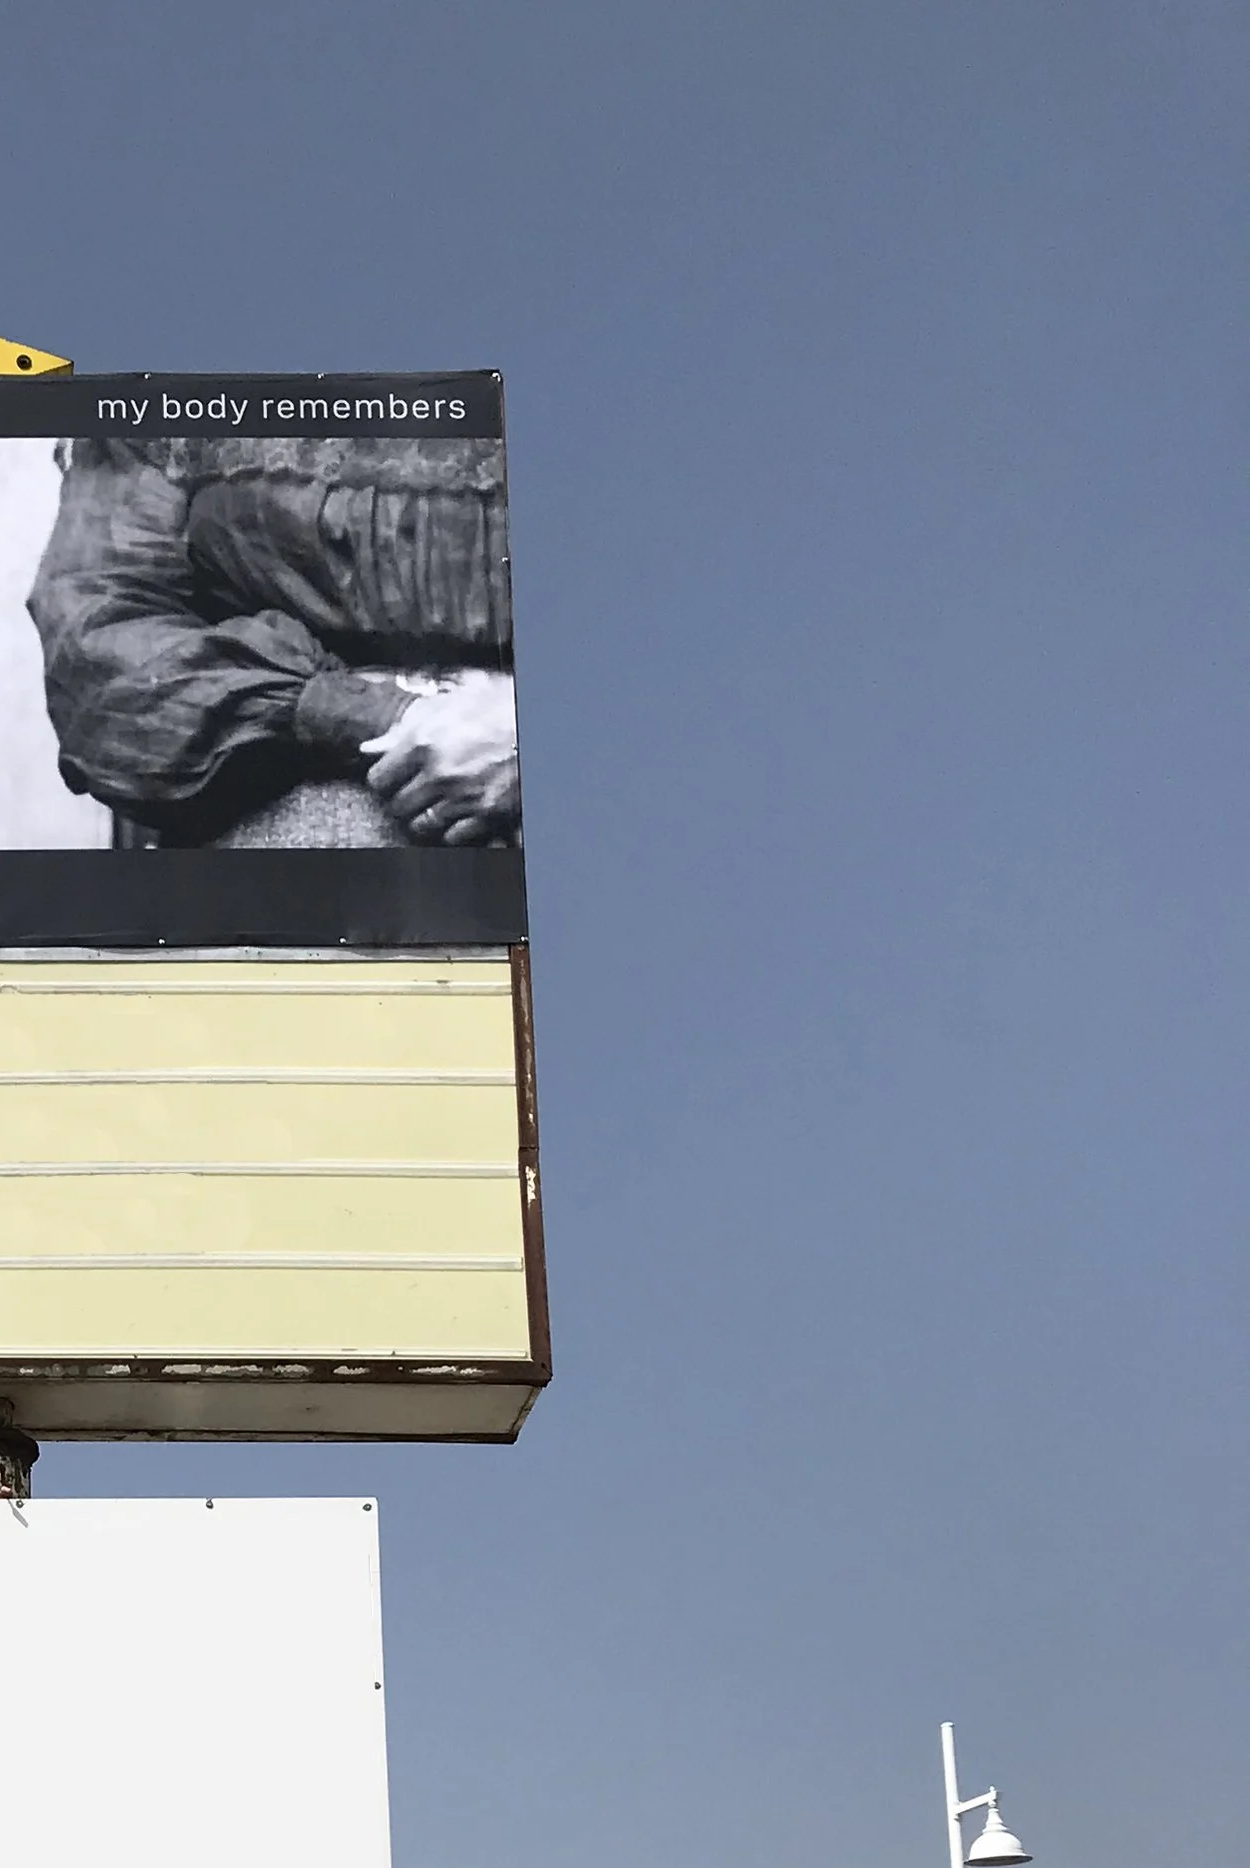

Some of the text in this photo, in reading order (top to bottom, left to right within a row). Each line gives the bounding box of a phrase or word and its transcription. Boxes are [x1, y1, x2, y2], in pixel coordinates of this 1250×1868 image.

[97, 393, 467, 425] my body remembers
